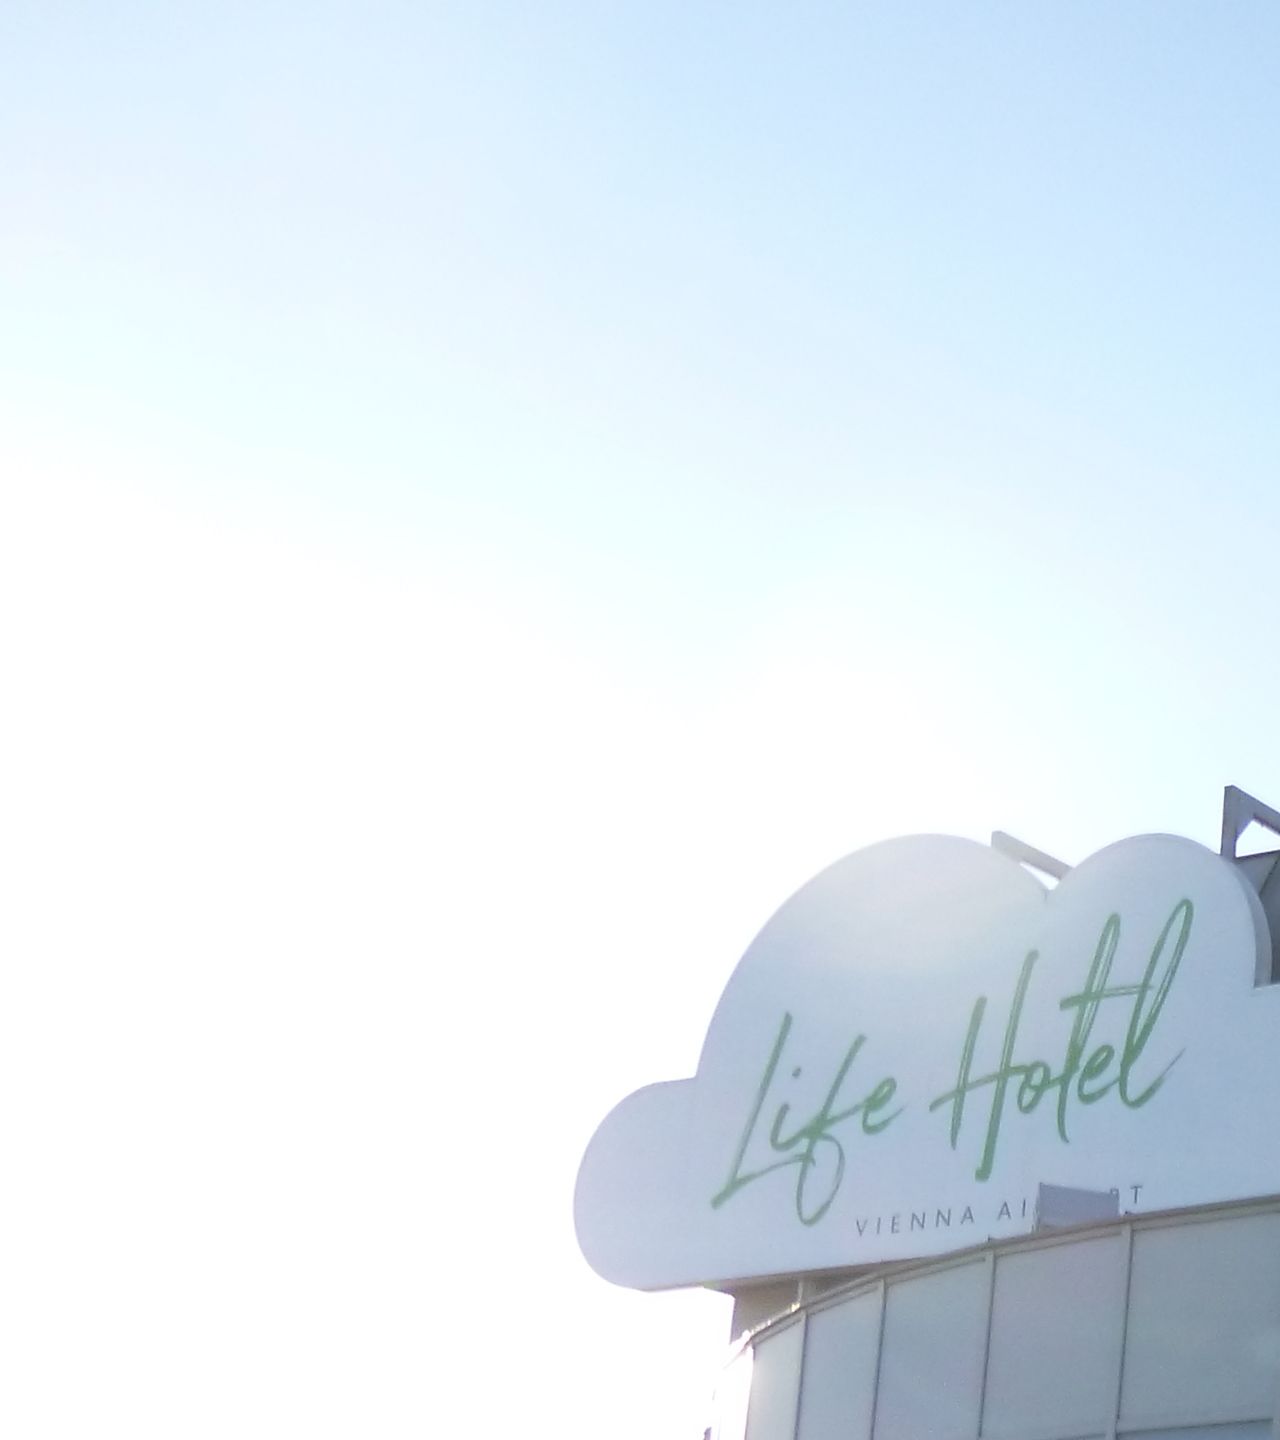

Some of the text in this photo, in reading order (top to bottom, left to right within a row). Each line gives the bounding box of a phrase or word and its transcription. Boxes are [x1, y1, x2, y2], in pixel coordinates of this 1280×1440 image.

[712, 898, 1193, 1226] Life Hotel
[855, 1205, 976, 1237] VIENNA
